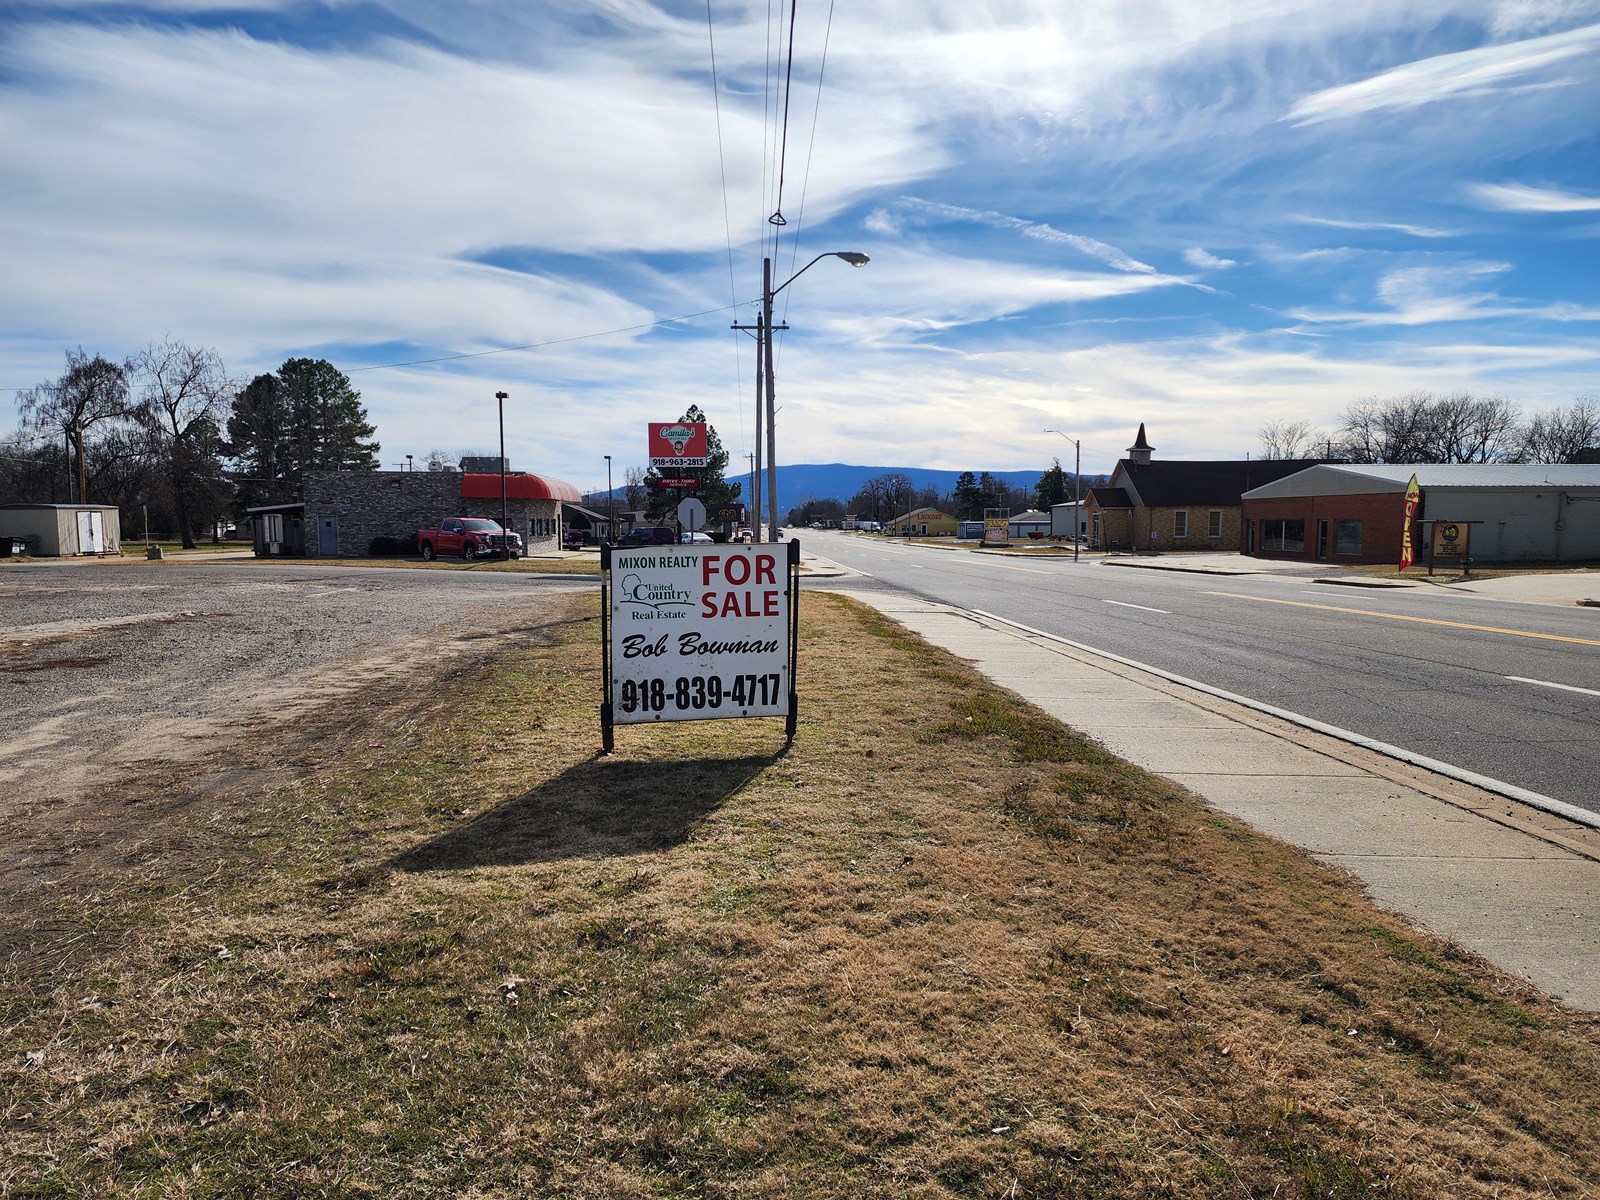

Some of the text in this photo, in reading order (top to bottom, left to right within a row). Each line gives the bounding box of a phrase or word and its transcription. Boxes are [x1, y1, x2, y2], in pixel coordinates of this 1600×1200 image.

[660, 427, 695, 438] Camila's
[652, 458, 704, 466] 918-963-2815
[1402, 502, 1413, 562] OPEN
[618, 556, 699, 569] MIXON REALTY
[702, 554, 777, 586] FOR
[633, 584, 691, 602] Country
[647, 583, 673, 592] United
[701, 590, 780, 619] SALE
[631, 610, 687, 620] Real Estate
[621, 632, 779, 659] Bob Bowman
[621, 673, 781, 713] 918-839-4717
